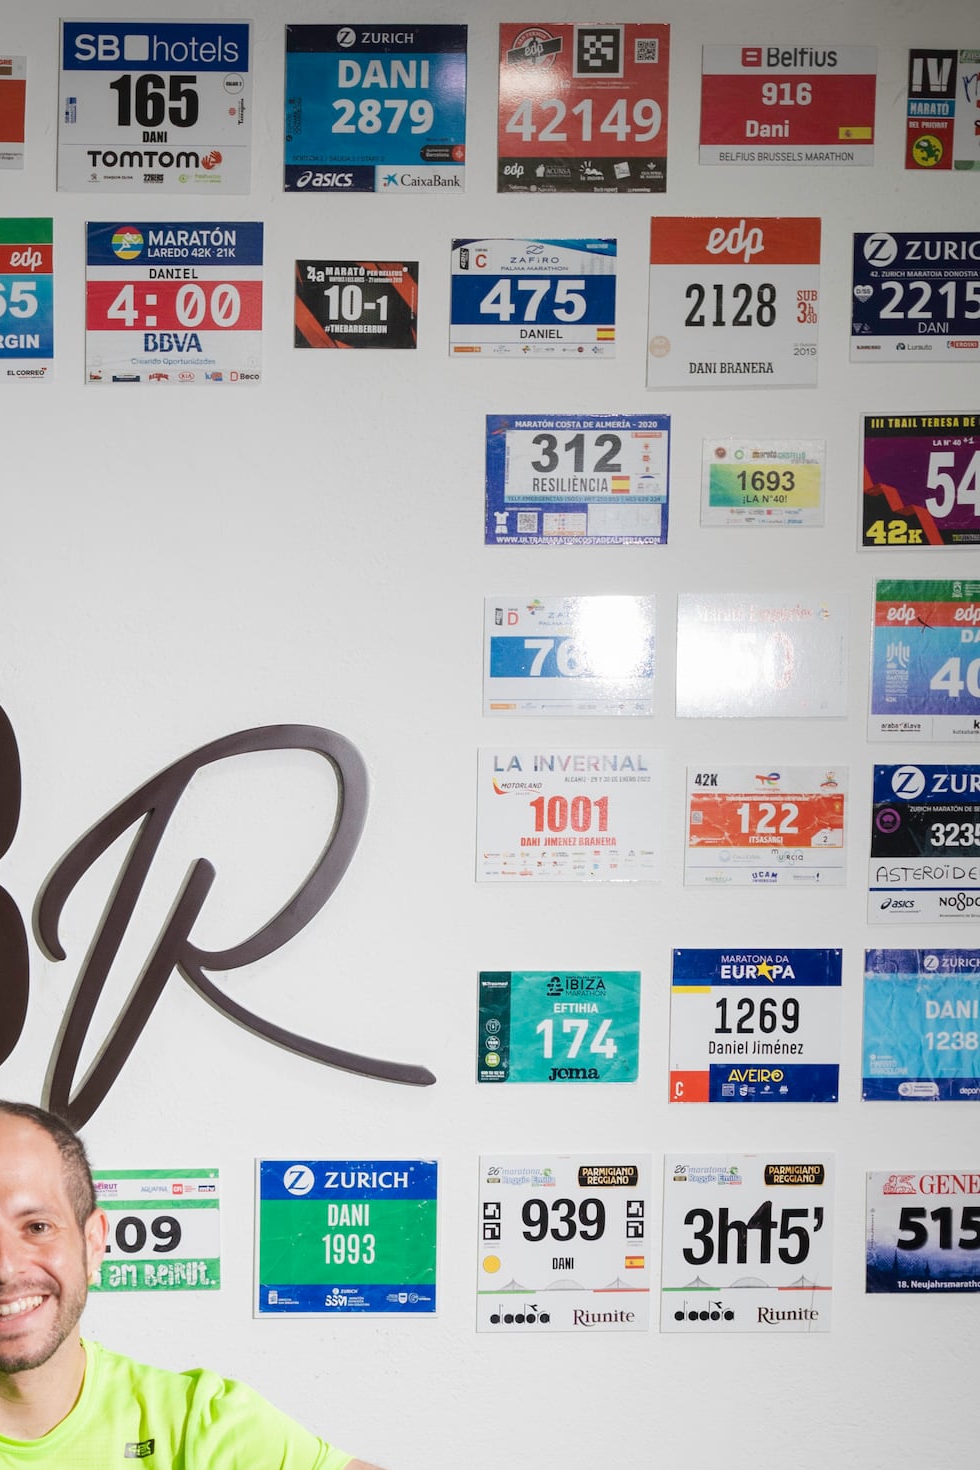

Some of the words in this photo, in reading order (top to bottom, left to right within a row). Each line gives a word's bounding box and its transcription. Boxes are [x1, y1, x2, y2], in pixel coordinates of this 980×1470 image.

[361, 33, 414, 44] ZURICH
[767, 46, 838, 68] Belfius
[337, 59, 430, 89] DANI
[110, 74, 199, 127] 165
[762, 82, 813, 106] 916
[331, 99, 434, 136] 2879
[506, 98, 662, 143] 42149
[142, 131, 168, 144] DANI
[746, 119, 790, 138] Dani
[719, 152, 756, 162] BELFIUS
[758, 152, 802, 162] BRUSSELS
[805, 152, 854, 162] MARATHON
[400, 173, 461, 188] CaixaBank
[148, 226, 237, 246] MARATÓN
[706, 219, 765, 263] edp
[148, 248, 188, 259] LAREDO
[149, 268, 198, 280] DANIEL
[107, 284, 241, 327] 4:00
[324, 284, 388, 321] 10-1
[480, 278, 587, 322] 475
[685, 283, 777, 327] 2128
[797, 290, 817, 302] SUB
[880, 281, 980, 320] 2215
[325, 324, 388, 335] #THEBARBERRUN
[520, 328, 563, 341] DANIEL
[918, 321, 949, 335] DANI
[144, 333, 203, 352] BBVA
[689, 362, 717, 375] DANI
[720, 361, 774, 375] BRANERA
[888, 418, 917, 429] TRAIL
[922, 417, 959, 428] TERESA
[531, 433, 622, 473] 312
[532, 474, 609, 493] RESILIÈNCIA
[736, 469, 797, 491] 1693
[867, 519, 923, 545] 42K
[493, 755, 523, 773] LA
[533, 754, 649, 773] INVERNAL
[529, 796, 609, 833] 1001
[736, 802, 799, 835] 122
[877, 865, 977, 883] ASTEROÏDE
[721, 954, 773, 964] MARATONA
[564, 978, 606, 991] IBIZA
[552, 1002, 599, 1015] EFTIHIA
[714, 997, 801, 1035] 1269
[924, 999, 978, 1020] DANI
[536, 1019, 618, 1060] 174
[708, 1040, 748, 1055] Daniel
[752, 1038, 804, 1055] Jiménez
[924, 1031, 979, 1051] 1238
[728, 1068, 785, 1083] AVEIRO
[324, 1171, 409, 1189] ZURICH
[581, 1166, 635, 1177] PARMIGIANO
[586, 1175, 630, 1186] REGGIANO
[327, 1203, 370, 1227] DANI
[521, 1197, 607, 1242] 939
[322, 1233, 376, 1265] 1993
[552, 1256, 575, 1270] DANI
